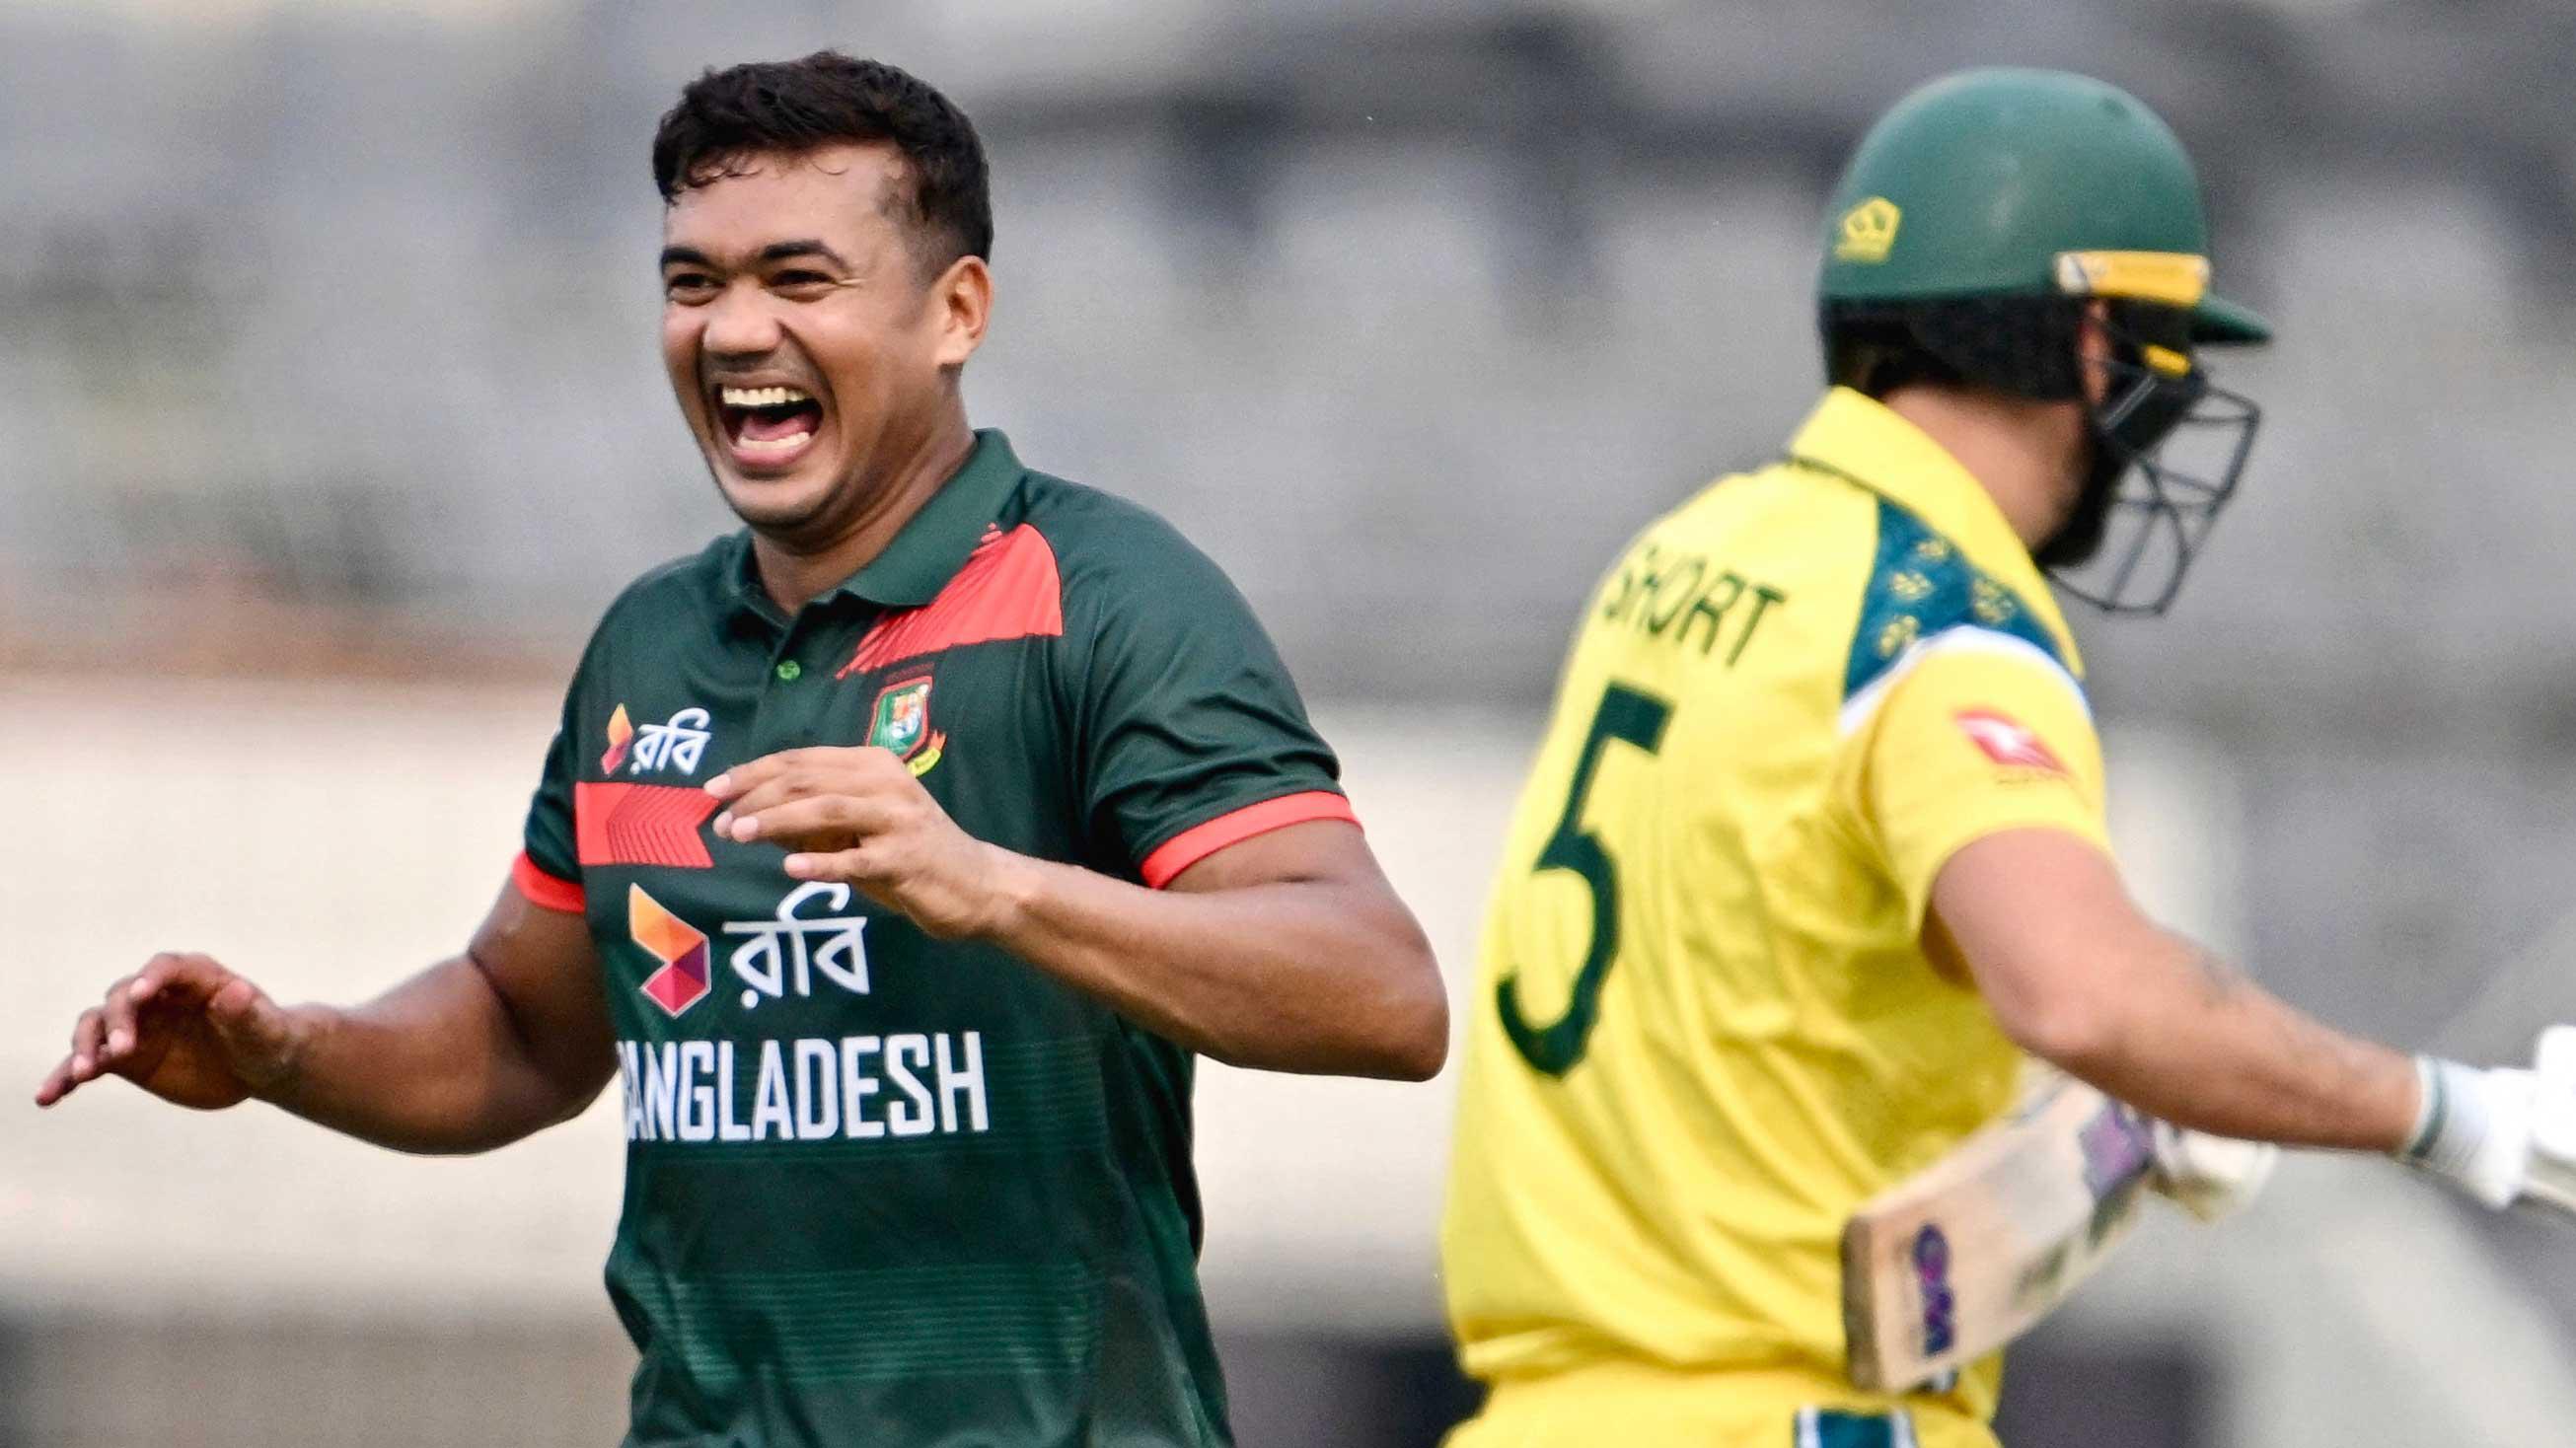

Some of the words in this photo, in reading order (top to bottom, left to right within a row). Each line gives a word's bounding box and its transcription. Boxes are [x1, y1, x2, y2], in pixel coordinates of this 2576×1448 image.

[630, 707, 710, 774] রবি
[1496, 681, 1673, 1079] 5
[723, 881, 870, 1010] রবি
[616, 1031, 989, 1141] ANGLADESH
